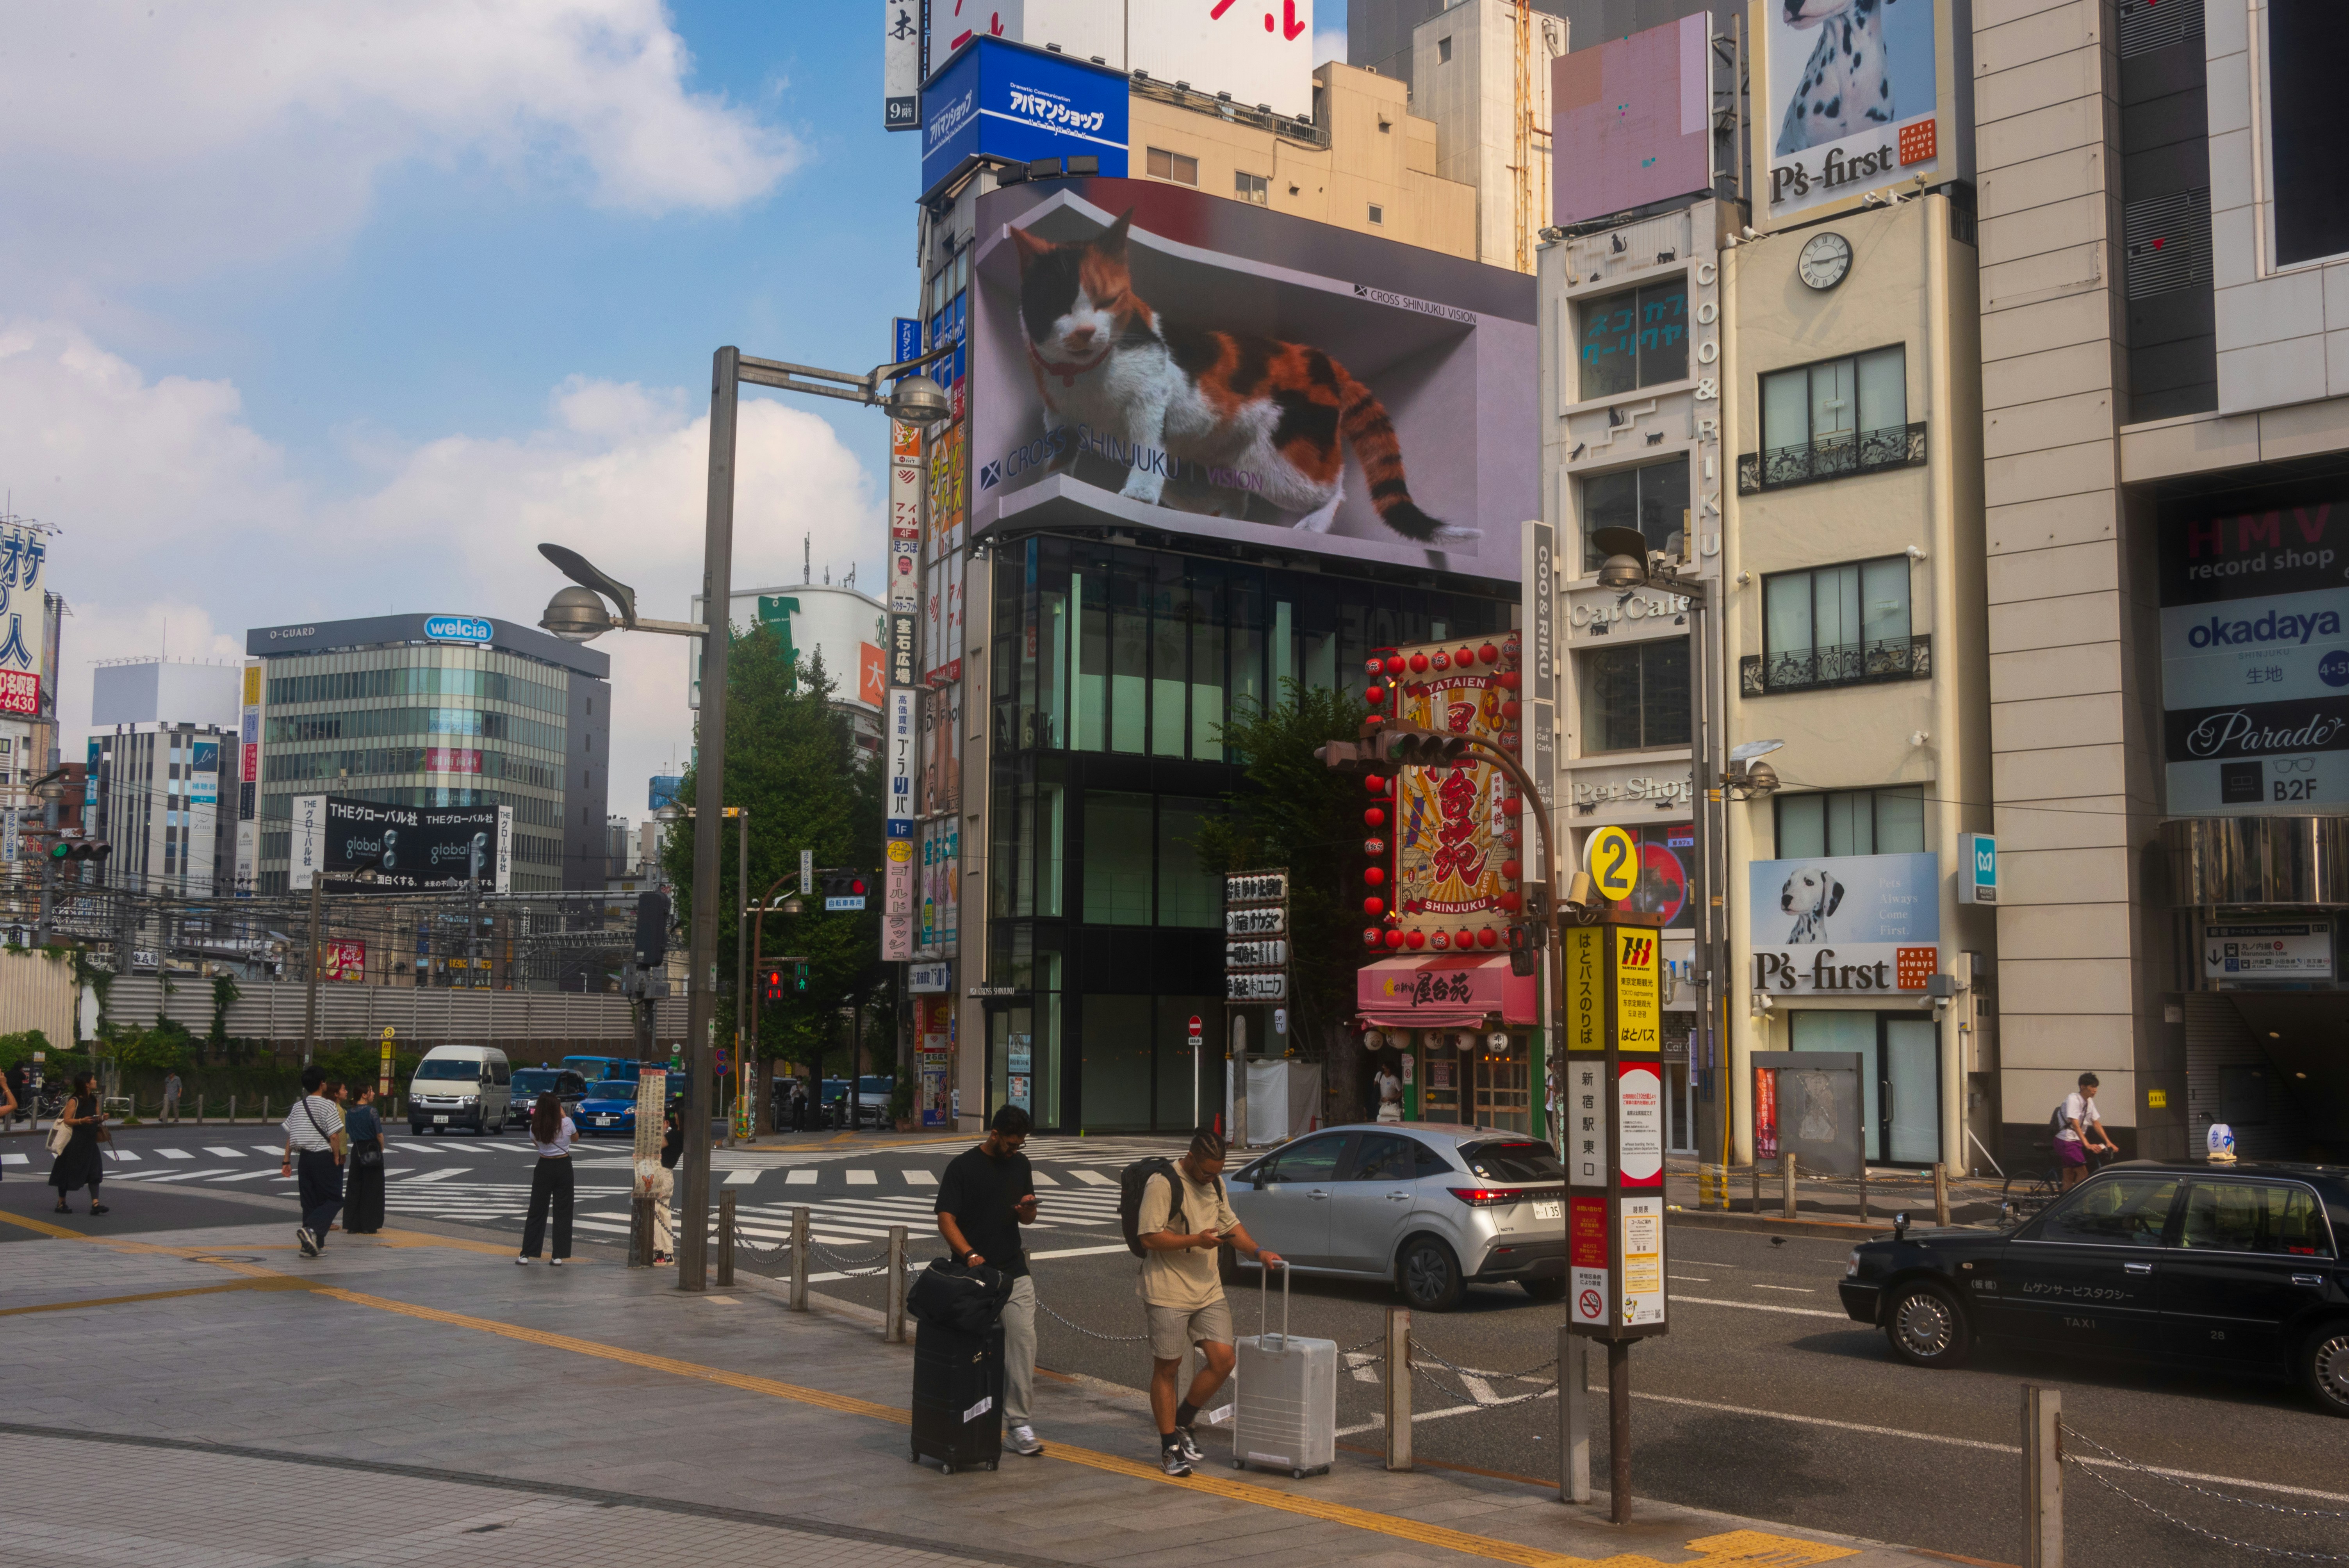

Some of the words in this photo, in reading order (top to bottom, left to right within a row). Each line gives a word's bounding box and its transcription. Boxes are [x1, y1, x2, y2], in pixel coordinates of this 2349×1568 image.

[1010, 82, 1033, 94] Dramatic
[1034, 90, 1071, 104] Communication
[890, 103, 912, 119] 9階
[930, 89, 972, 144] アパマンショップ
[1010, 91, 1104, 131] アパマンショップ
[1901, 123, 1932, 137] Pets
[1902, 132, 1932, 145] always
[1902, 140, 1932, 154] come
[1902, 148, 1932, 162] first
[1370, 289, 1400, 307] CROSS
[1403, 295, 1445, 317] SHINJUKU
[1447, 305, 1477, 324] VISION
[1695, 378, 1718, 400] &
[1007, 424, 1067, 477] CROSS
[1077, 423, 1181, 480] SHINJUKU
[1207, 467, 1264, 491] VISION
[896, 502, 917, 513] アイ
[896, 515, 917, 526] フル
[900, 529, 912, 538] 4F
[2189, 502, 2331, 558] HMV
[893, 540, 918, 554] 足つぼ
[0, 525, 46, 590] オケ
[2190, 552, 2266, 580] record
[2274, 548, 2335, 569] shop
[1538, 546, 1548, 595] COO
[892, 600, 918, 613] ドクターフット
[1538, 599, 1548, 615] &
[1570, 602, 1622, 628] Cat
[1625, 593, 1691, 619] Cafe
[270, 627, 315, 640] O-GUARD
[430, 619, 487, 638] welcia
[2188, 609, 2341, 649] okadaya
[896, 618, 911, 683] 宝石広場
[1539, 621, 1549, 679] RIKU
[2238, 648, 2290, 660] SHINJUKU
[867, 661, 885, 693] 大
[2246, 666, 2283, 684] 生地
[1426, 677, 1486, 694] YATAIEN
[898, 695, 907, 735] 高価買取
[1536, 732, 1549, 742] Cat
[2187, 709, 2344, 756] Parade
[1536, 743, 1552, 752] Cafe
[895, 738, 908, 814] ブラリバ
[1571, 781, 1618, 803] Pet
[1627, 777, 1693, 804] Shop
[2274, 778, 2317, 802] B2F
[330, 803, 418, 826] THEグローバル社
[426, 813, 493, 825] THEグローバル社
[303, 800, 317, 866] THEグローバル社
[895, 823, 907, 834] 1F
[347, 836, 381, 859] global
[500, 811, 511, 873] THEグローバル社
[894, 842, 907, 850] ハン
[431, 842, 469, 864] global
[1603, 834, 1628, 889] 2
[891, 865, 907, 913] ゴールド
[1878, 877, 1901, 888] Pets
[828, 899, 863, 908] 自転車専用
[1425, 898, 1486, 912] SHINJUKU
[1879, 893, 1918, 904] Always
[1879, 909, 1909, 920] Come
[889, 916, 907, 960] ラッシュ
[1879, 925, 1909, 935] First.
[2210, 927, 2228, 935] 新宿
[1899, 950, 1933, 958] Pets
[2241, 942, 2272, 951] 丸ノ内線
[1899, 959, 1934, 968] always
[916, 971, 930, 985] 高価買取
[1621, 977, 1653, 987] 東京定期観光
[1900, 978, 1927, 986] firs
[978, 987, 992, 996] CROSS
[993, 987, 1014, 995] SHINJUKU
[1410, 972, 1474, 1008] 屋台苑
[1578, 933, 1593, 1045] はとバスのりば
[1623, 999, 1652, 1008] 东京定期观光
[1621, 1027, 1655, 1041] はとバス
[935, 1077, 947, 1120] ハンバーグ
[1582, 1072, 1595, 1176] 新宿駅東口
[1633, 1205, 1649, 1213] 時刻表
[2023, 1282, 2134, 1300] ムゲンサービスタクシー
[2064, 1317, 2096, 1329] TAXI
[2210, 1331, 2225, 1340] 28
